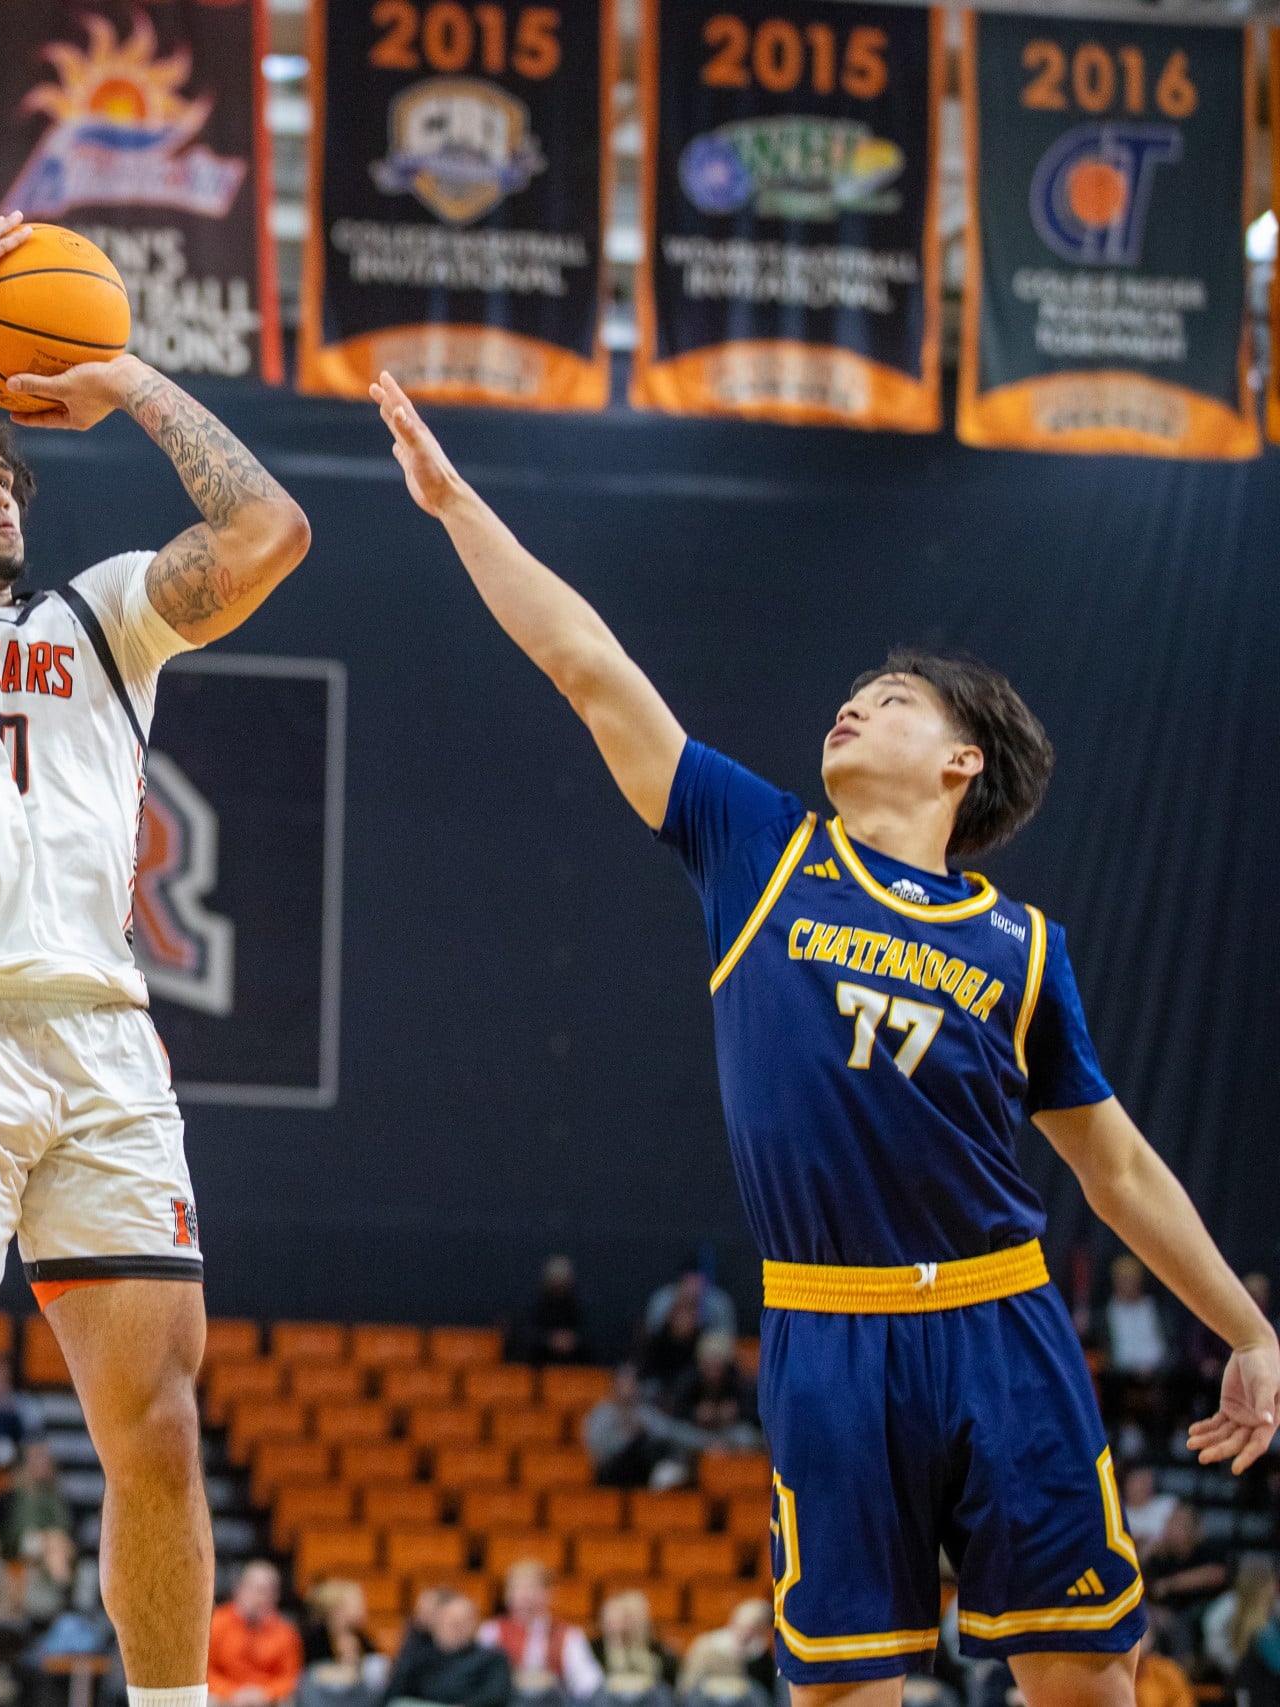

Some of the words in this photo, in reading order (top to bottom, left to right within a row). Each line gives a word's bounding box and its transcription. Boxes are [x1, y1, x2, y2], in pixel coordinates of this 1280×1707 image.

[369, 0, 562, 80] 2015
[701, 15, 889, 98] 2015
[1022, 40, 1197, 119] 2016
[787, 917, 1006, 1024] CHATTANOOGA
[835, 980, 946, 1080] 77
